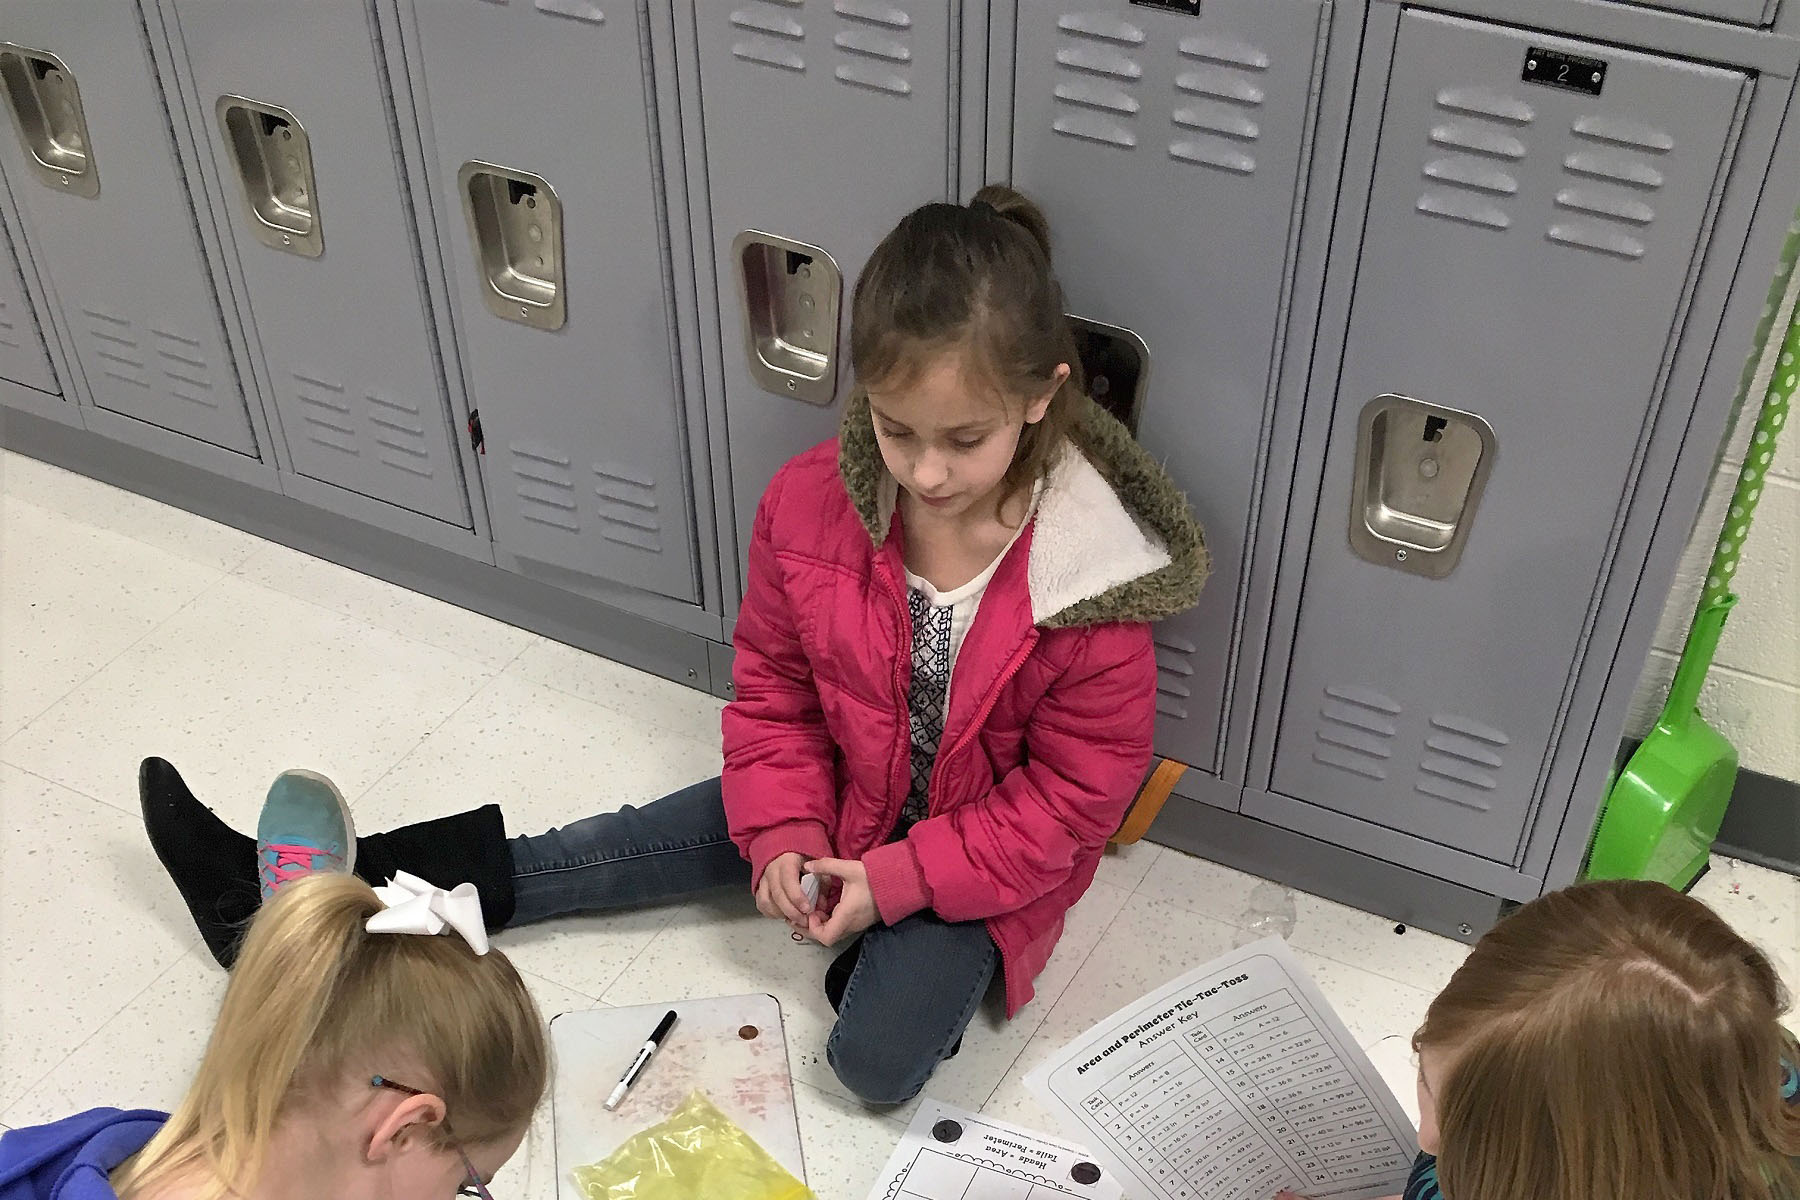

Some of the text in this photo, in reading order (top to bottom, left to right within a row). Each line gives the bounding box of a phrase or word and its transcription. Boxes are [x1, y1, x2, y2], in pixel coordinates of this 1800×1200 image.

[1557, 64, 1569, 81] 2
[1233, 1004, 1267, 1021] Answers
[1139, 1011, 1199, 1048] Answer Key
[1191, 1030, 1203, 1038] Task
[1077, 1055, 1102, 1075] Area
[1103, 1041, 1122, 1057] and
[1121, 1008, 1174, 1043] Perimeter
[1194, 1034, 1207, 1043] Card
[1129, 1061, 1155, 1080] Answers
[1088, 1096, 1098, 1105] Task
[1091, 1100, 1103, 1110] Card
[984, 1135, 1027, 1153] Perimeter
[986, 1146, 1007, 1158] Area
[1037, 1150, 1057, 1163] Tails
[1019, 1157, 1046, 1169] Heads
